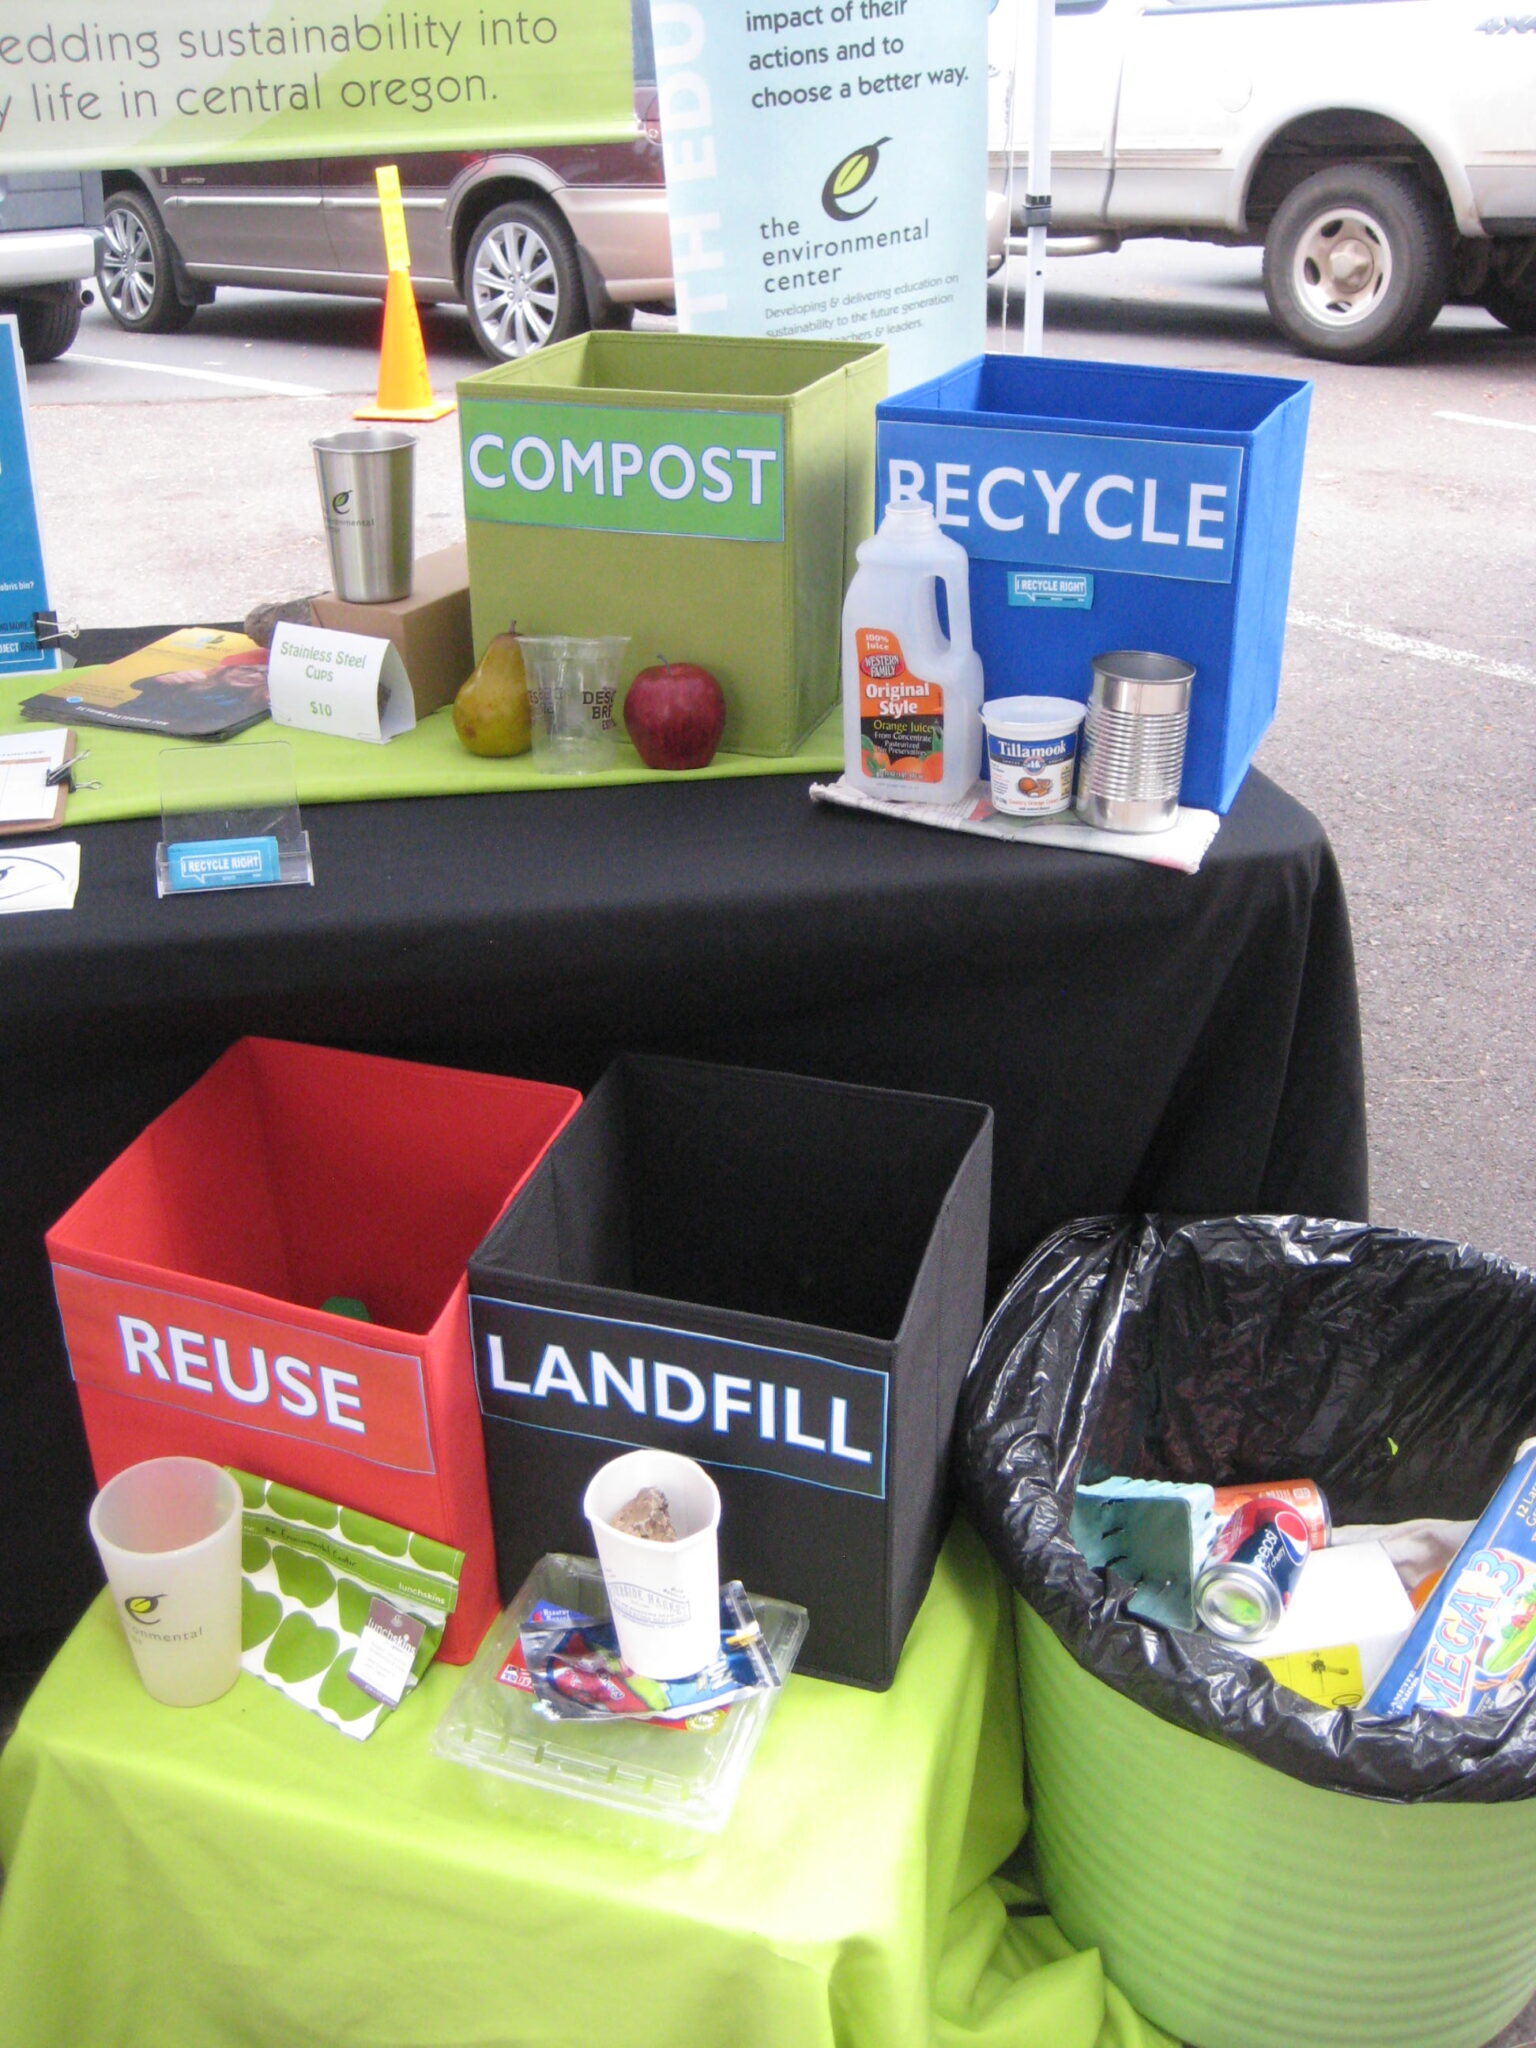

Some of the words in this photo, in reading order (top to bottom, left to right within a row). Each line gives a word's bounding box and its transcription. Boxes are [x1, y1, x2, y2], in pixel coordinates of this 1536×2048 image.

[746, 6, 825, 34] impact
[831, 0, 854, 22] of
[860, 0, 908, 20] their
[0, 23, 160, 69] edding
[179, 13, 462, 60] sustainability
[479, 10, 558, 49] into
[749, 46, 829, 71] actions
[836, 36, 876, 61] and
[882, 37, 904, 54] to
[32, 82, 102, 122] life
[119, 80, 157, 118] in
[177, 73, 322, 117] central
[341, 73, 498, 113] oregon.
[751, 85, 833, 108] choose
[839, 83, 851, 98] a
[858, 72, 922, 96] better
[927, 66, 969, 87] way.
[760, 217, 801, 241] the
[762, 218, 930, 267] environmental
[764, 266, 843, 293] center
[765, 299, 828, 320] Developing
[842, 286, 893, 306] delivering
[894, 278, 943, 296] education
[945, 274, 960, 284] on
[836, 316, 850, 327] to
[851, 310, 869, 324] the
[468, 433, 778, 505] COMPOST
[888, 458, 1227, 550] RECYCLE
[1021, 579, 1058, 592] RECYCLE
[1060, 581, 1085, 593] RIGHT
[865, 633, 889, 643] 100%
[866, 642, 889, 651] Juice
[280, 641, 333, 663] Stainless
[335, 651, 368, 669] Steel
[864, 654, 899, 667] WESTERN
[305, 664, 335, 682] Cups
[870, 664, 896, 679] FAMILY
[866, 682, 930, 701] Original
[310, 701, 333, 717] $10
[879, 700, 918, 719] Style
[873, 719, 908, 735] Orange
[910, 720, 933, 734] Juice
[874, 731, 892, 740] From
[892, 731, 932, 743] Concentrate
[998, 739, 1067, 758] Tillamook
[188, 857, 230, 872] RECYCLE
[231, 855, 260, 869] RIGHT
[117, 1314, 366, 1433] REUSE
[487, 1333, 872, 1464] LANDFILL
[398, 1583, 445, 1605] lunchskins
[368, 1616, 417, 1658] lunchskins
